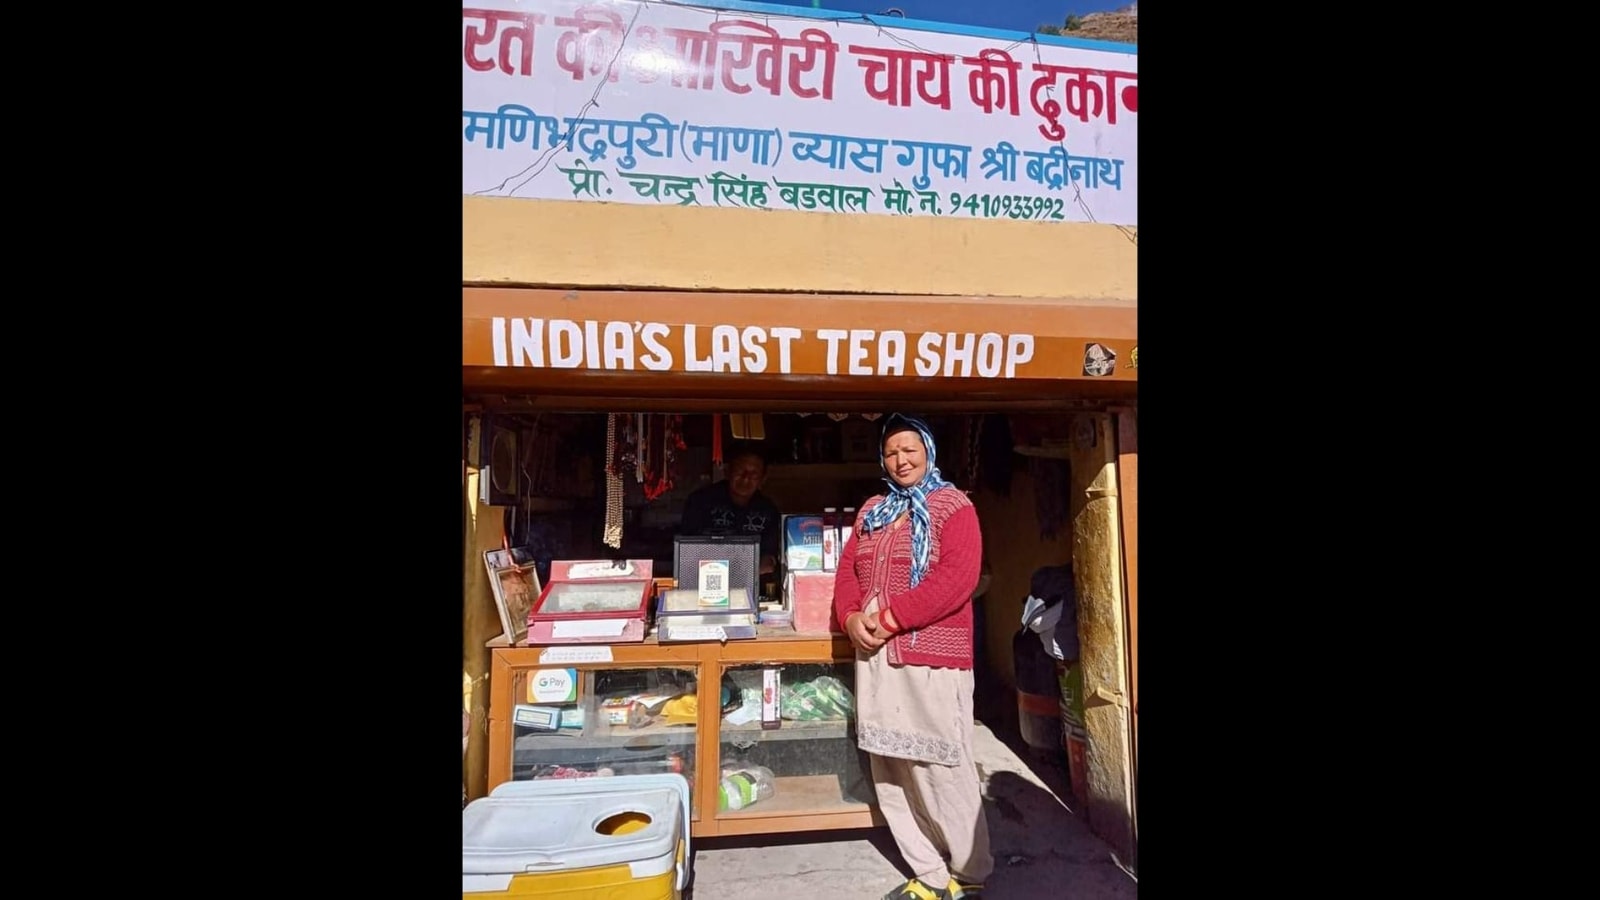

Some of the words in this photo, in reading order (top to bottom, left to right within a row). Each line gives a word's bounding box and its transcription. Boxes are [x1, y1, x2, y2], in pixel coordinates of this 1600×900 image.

[554, 5, 626, 83] की
[849, 45, 955, 110] चाय
[963, 49, 1022, 116] की
[788, 132, 889, 173] व्यास
[980, 141, 1020, 181] श्री
[616, 168, 703, 206] चन्द्र
[705, 171, 772, 207] सिंह
[950, 192, 1065, 220] 9410933992
[492, 317, 672, 371] INDIA'S
[684, 324, 801, 374] LAST
[817, 329, 904, 376] TEA
[914, 332, 1035, 379] SHOP
[549, 677, 566, 688] Pay
